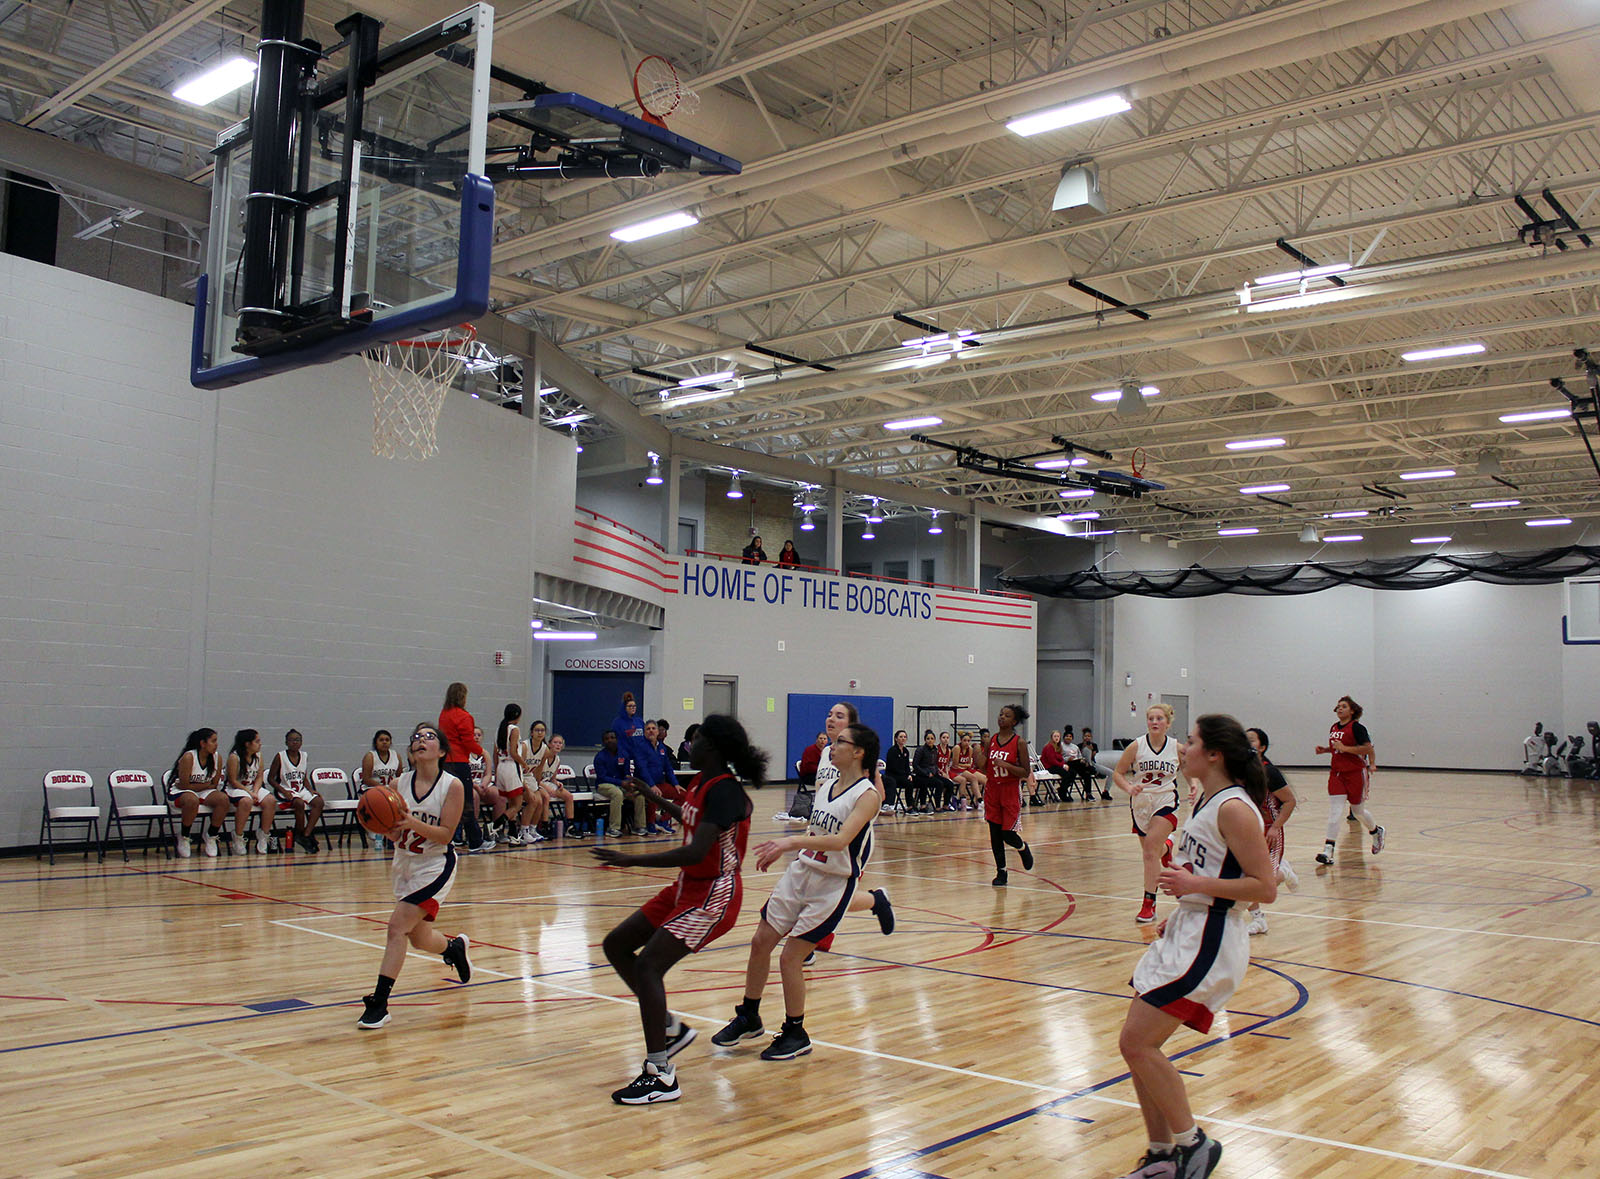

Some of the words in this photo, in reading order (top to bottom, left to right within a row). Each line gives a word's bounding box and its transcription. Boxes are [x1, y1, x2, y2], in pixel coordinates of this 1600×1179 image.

[684, 562, 756, 602] HOME
[763, 573, 793, 605] OF
[799, 577, 840, 610] THE
[846, 583, 932, 620] BOBCATS
[565, 659, 645, 669] CONCESSIONS
[1330, 731, 1344, 739] EAST
[990, 750, 1009, 760] EAST
[1139, 760, 1175, 774] BOBCATS
[51, 775, 86, 784] BOBCATS
[116, 775, 147, 784] BOBCATS
[317, 772, 343, 780] BOBCATS
[1142, 773, 1166, 786] 32
[811, 808, 844, 834] BCATS
[399, 829, 427, 854] 12
